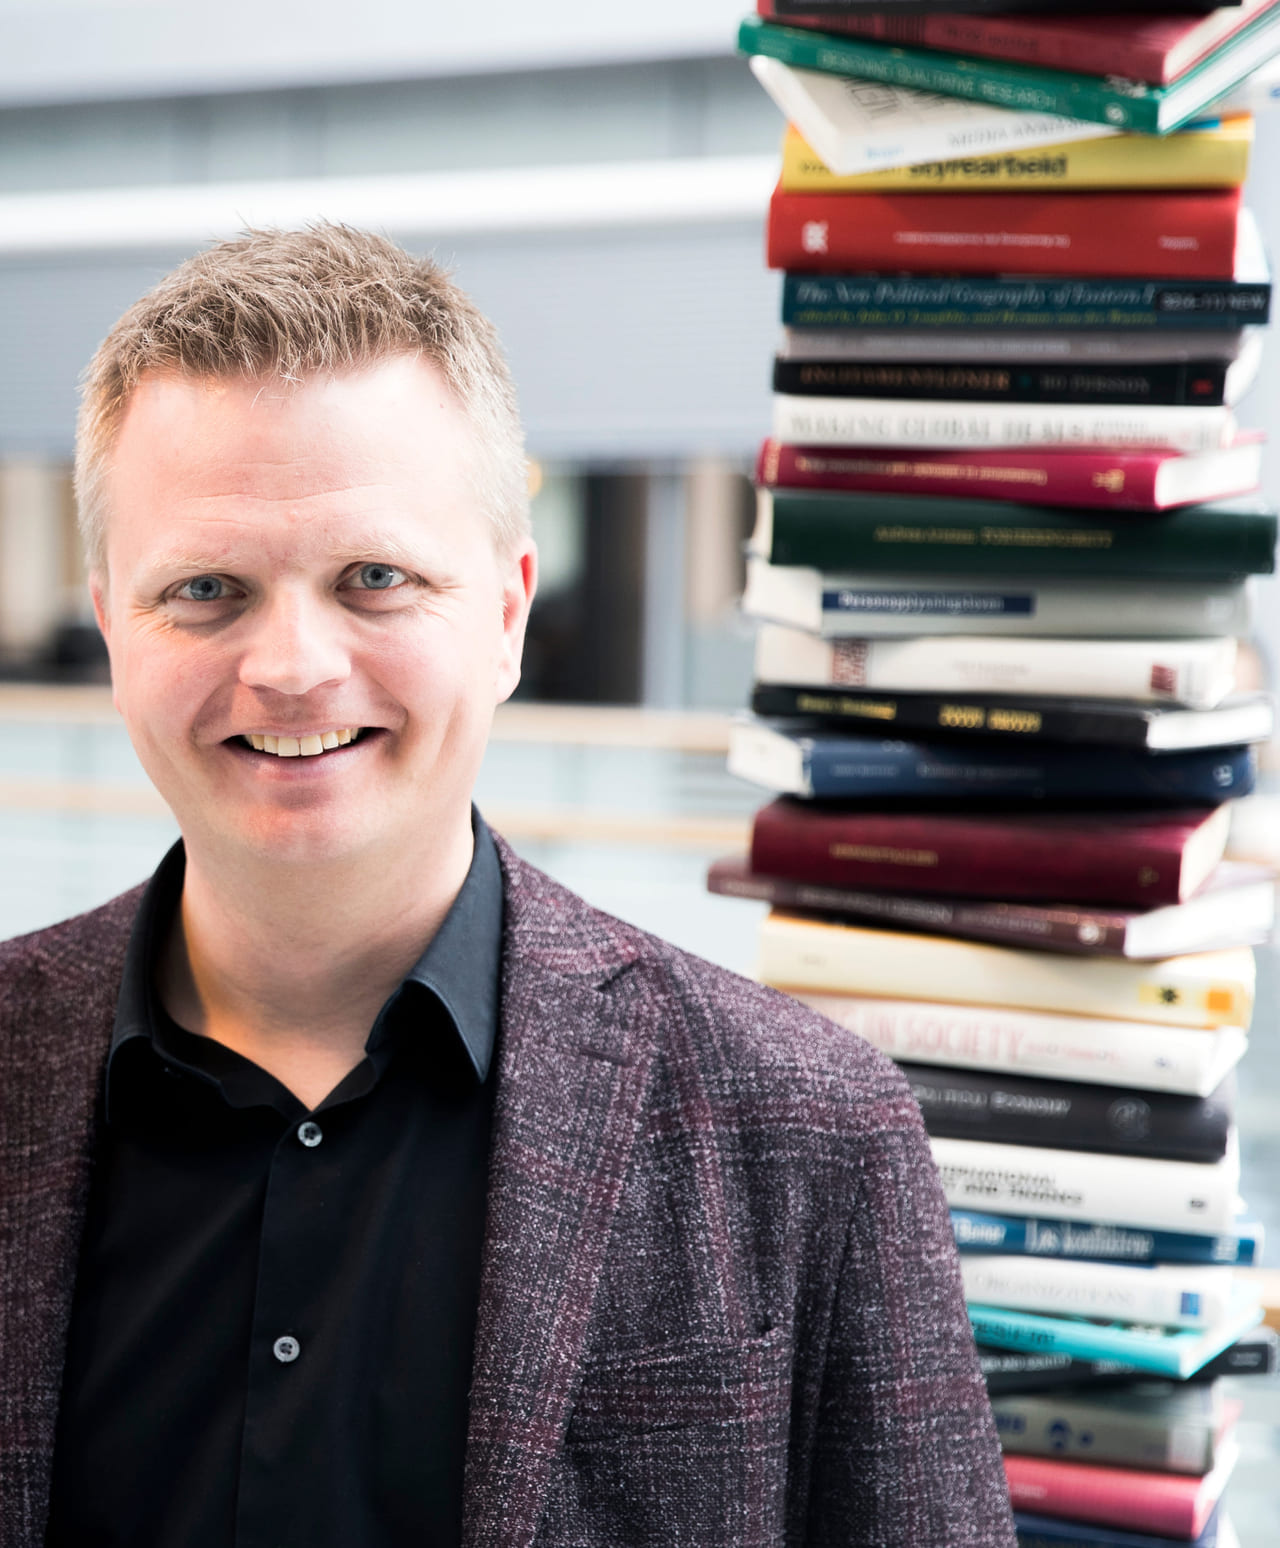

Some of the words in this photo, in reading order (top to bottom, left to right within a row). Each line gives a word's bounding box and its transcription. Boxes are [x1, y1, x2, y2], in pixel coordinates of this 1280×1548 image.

[980, 74, 1058, 112] RESEARCH
[873, 283, 950, 304] Political
[951, 283, 1046, 309] Geography
[906, 1015, 1027, 1062] SOCIETY
